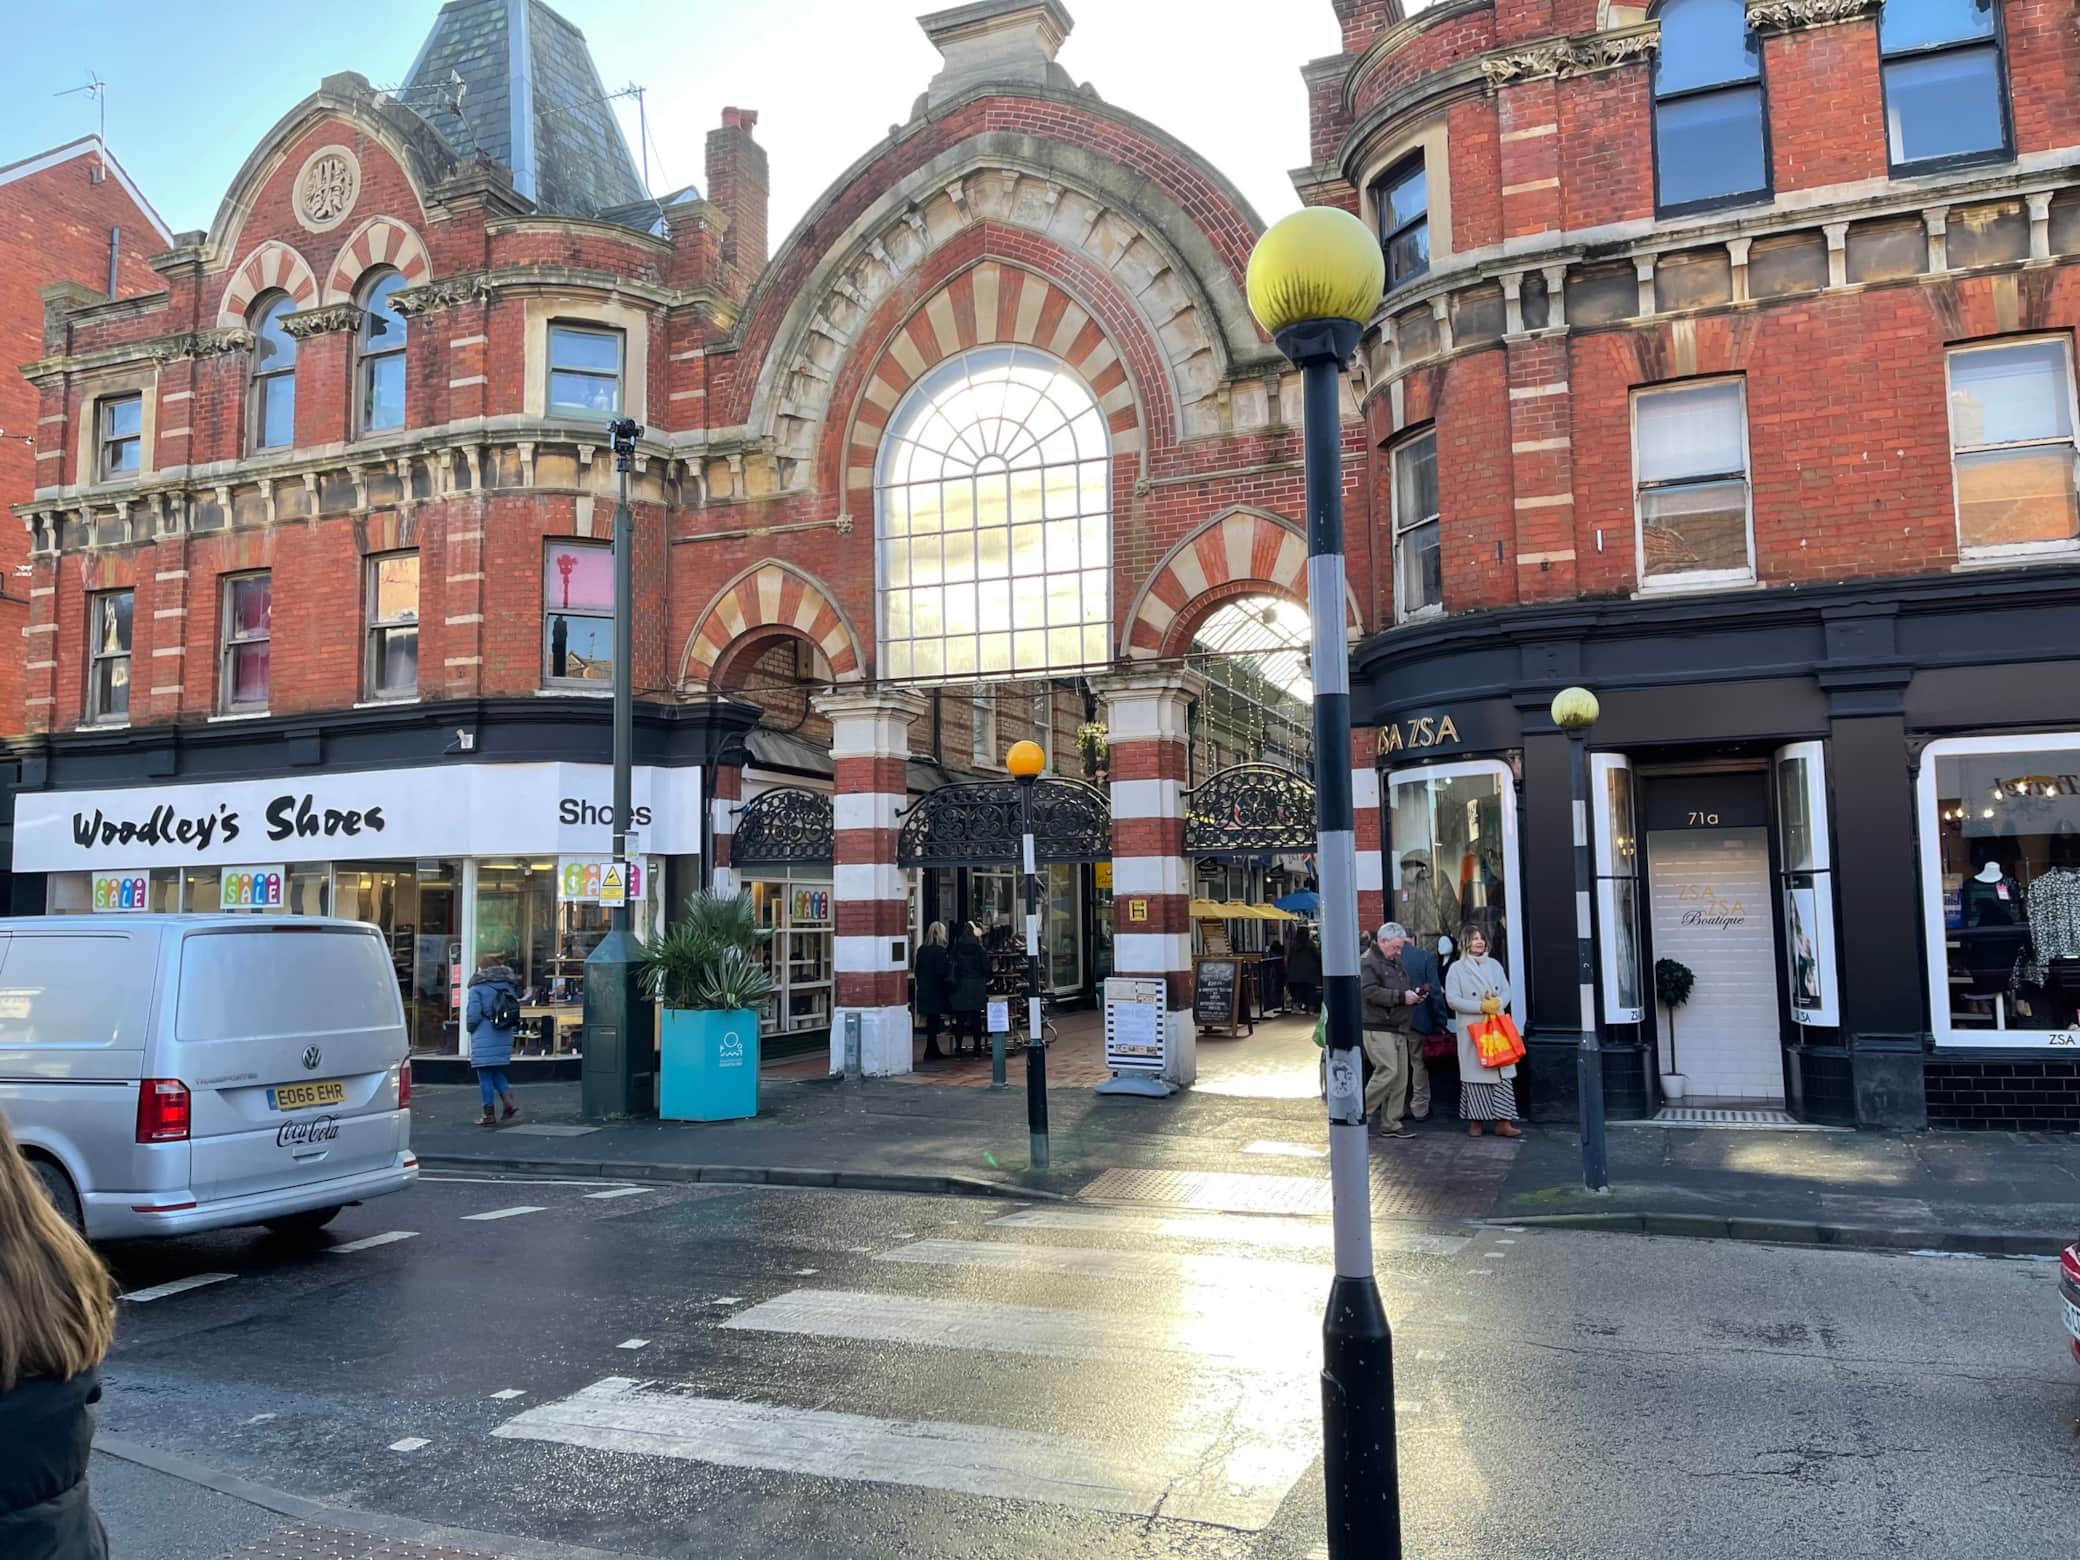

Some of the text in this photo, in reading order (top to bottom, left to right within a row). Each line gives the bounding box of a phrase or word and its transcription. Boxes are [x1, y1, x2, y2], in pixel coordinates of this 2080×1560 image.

[1407, 714, 1461, 748] ZSA
[559, 798, 652, 825] Shos
[1688, 811, 1720, 825] 71a
[73, 794, 385, 851] Woodley's Shoes
[96, 889, 143, 908] SALE
[227, 885, 278, 904] SALE
[1679, 884, 1713, 901] ZSA
[794, 901, 828, 919] SALE
[1680, 910, 1745, 930] Boutique
[2048, 1033, 2076, 1046] ZSA
[317, 1083, 345, 1101] EHR
